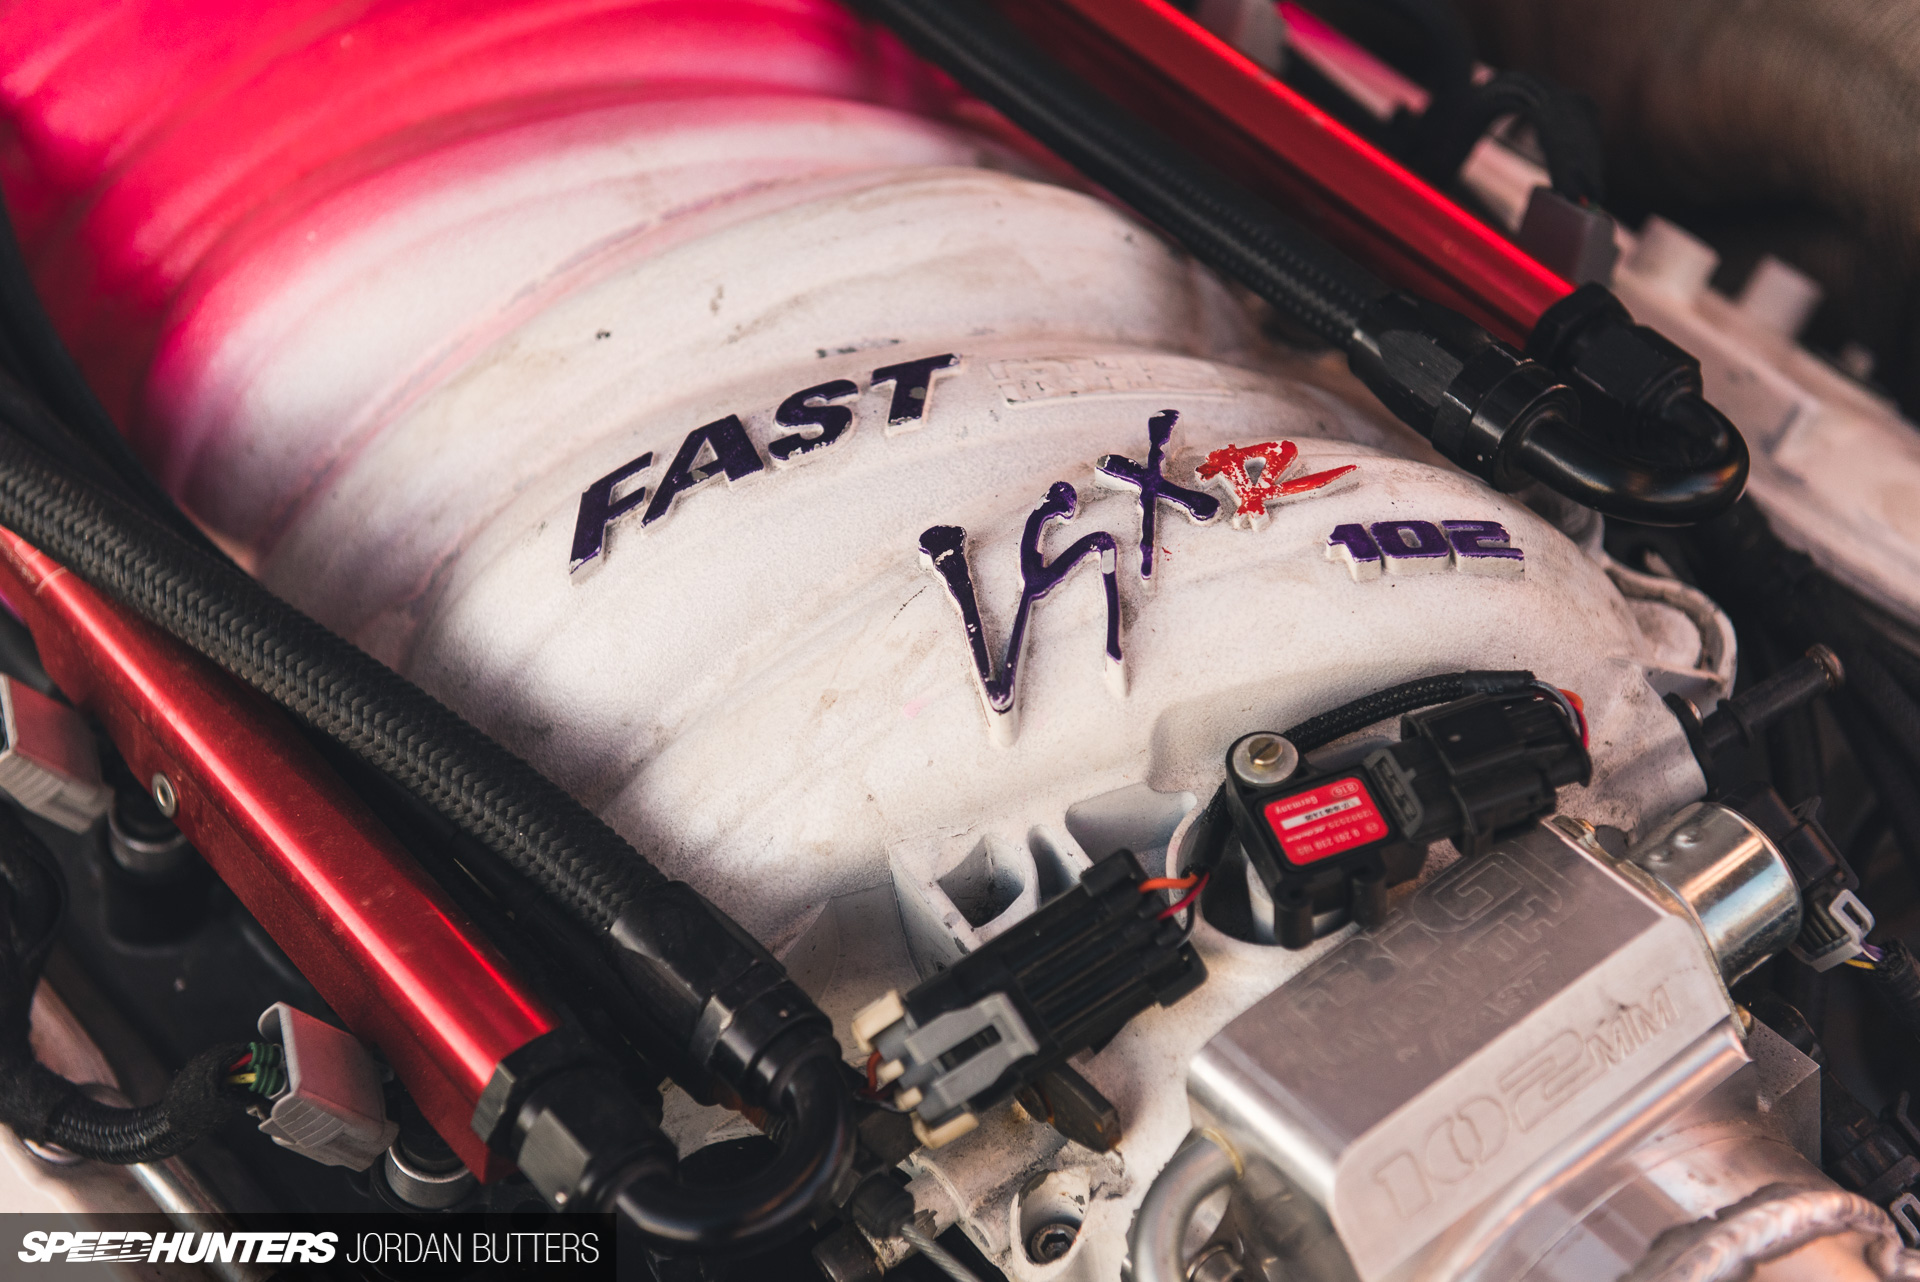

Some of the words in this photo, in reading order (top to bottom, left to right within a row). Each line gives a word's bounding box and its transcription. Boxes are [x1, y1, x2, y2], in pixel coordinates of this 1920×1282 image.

[569, 352, 961, 585] FAST
[1326, 519, 1526, 581] 102
[1275, 796, 1318, 814] Germany
